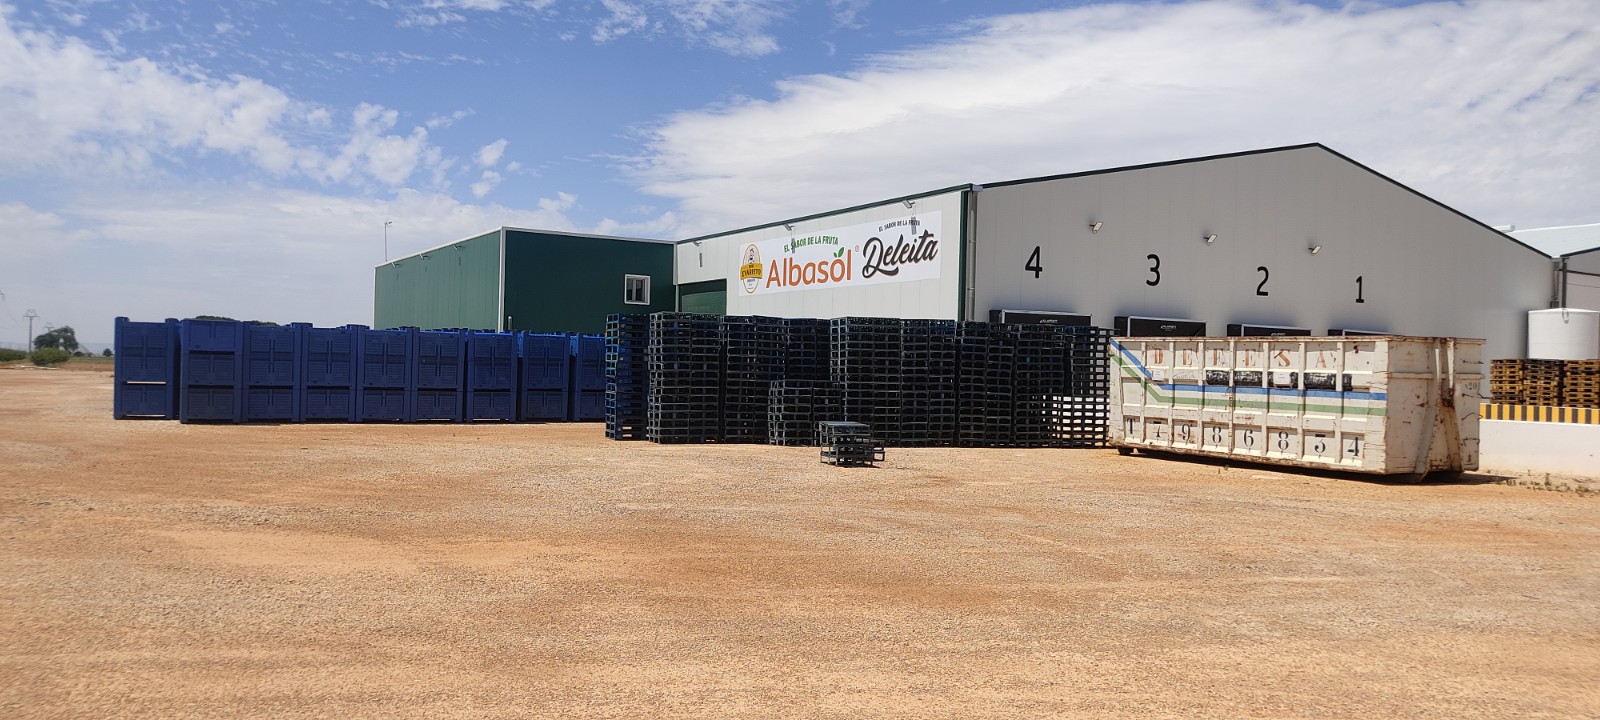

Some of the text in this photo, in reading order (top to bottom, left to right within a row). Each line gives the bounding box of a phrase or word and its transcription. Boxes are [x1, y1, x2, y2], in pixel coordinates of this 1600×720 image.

[783, 236, 839, 253] EL SABOR DE LA FRUTA
[861, 228, 939, 279] Deleita
[765, 248, 852, 289] Albasol
[1024, 245, 1043, 279] 4
[1145, 253, 1161, 287] 3
[1256, 266, 1269, 297] 2
[1355, 275, 1365, 304] 1
